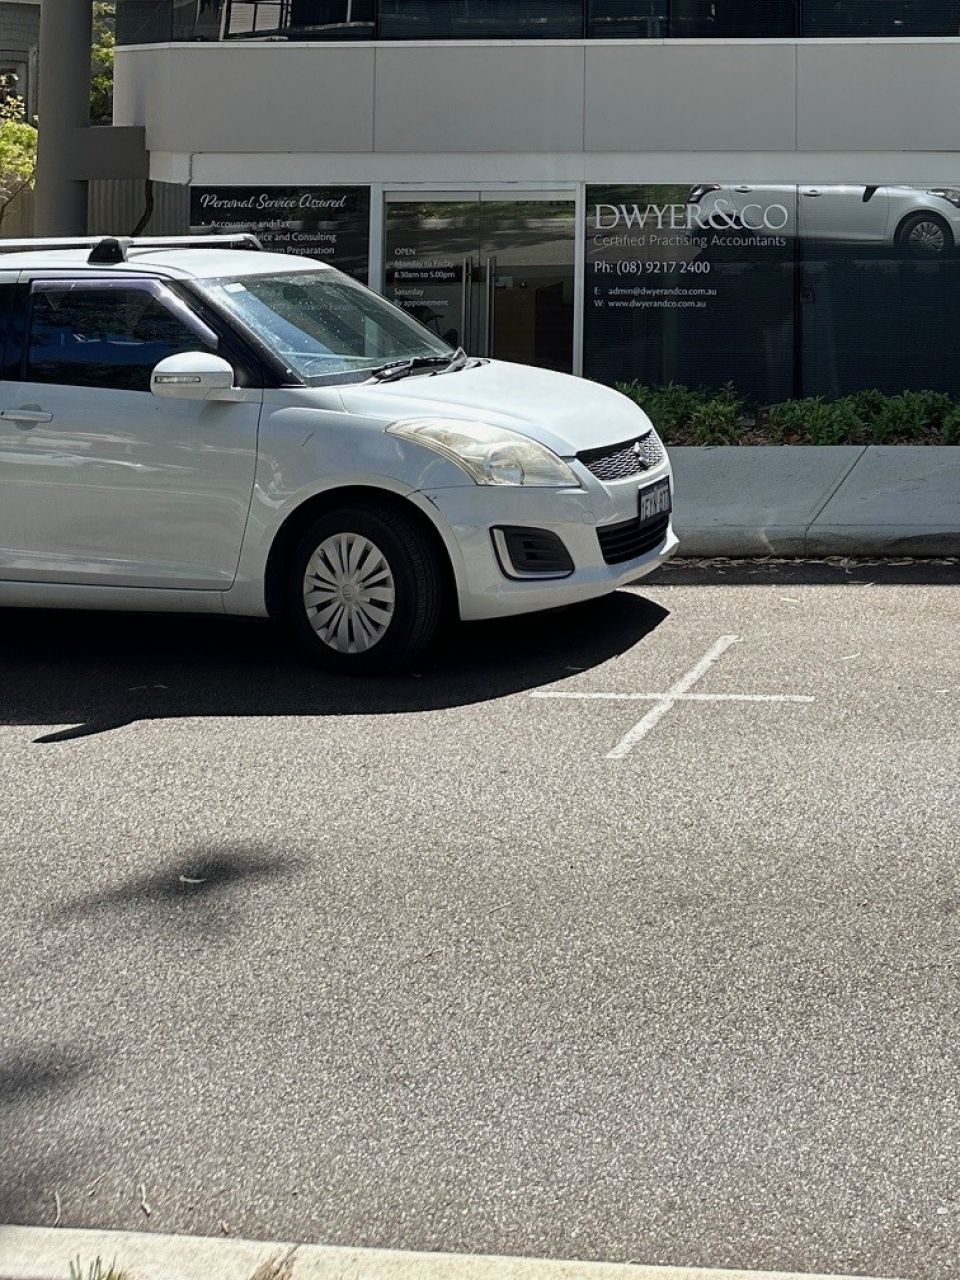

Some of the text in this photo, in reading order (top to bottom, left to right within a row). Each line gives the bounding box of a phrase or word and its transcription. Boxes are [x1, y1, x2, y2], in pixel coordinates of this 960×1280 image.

[200, 194, 347, 209] Personal Service Assured
[594, 199, 788, 231] DWYER&CO
[210, 220, 290, 230] Accounting and Tax
[274, 232, 290, 242] and
[292, 232, 337, 244] Consulting
[593, 234, 787, 249] Certified Practising Accountants
[286, 246, 335, 256] Preparation
[394, 260, 423, 269] Monday
[434, 260, 454, 269] Friday
[594, 260, 711, 276] Ph: (08) 9217 2400
[421, 271, 429, 279] to
[394, 288, 425, 297] Saturday
[608, 286, 717, 298] admin@dwyerandco.com.au
[404, 299, 449, 308] appointment
[608, 299, 707, 310] www.dwyerandco.com.au
